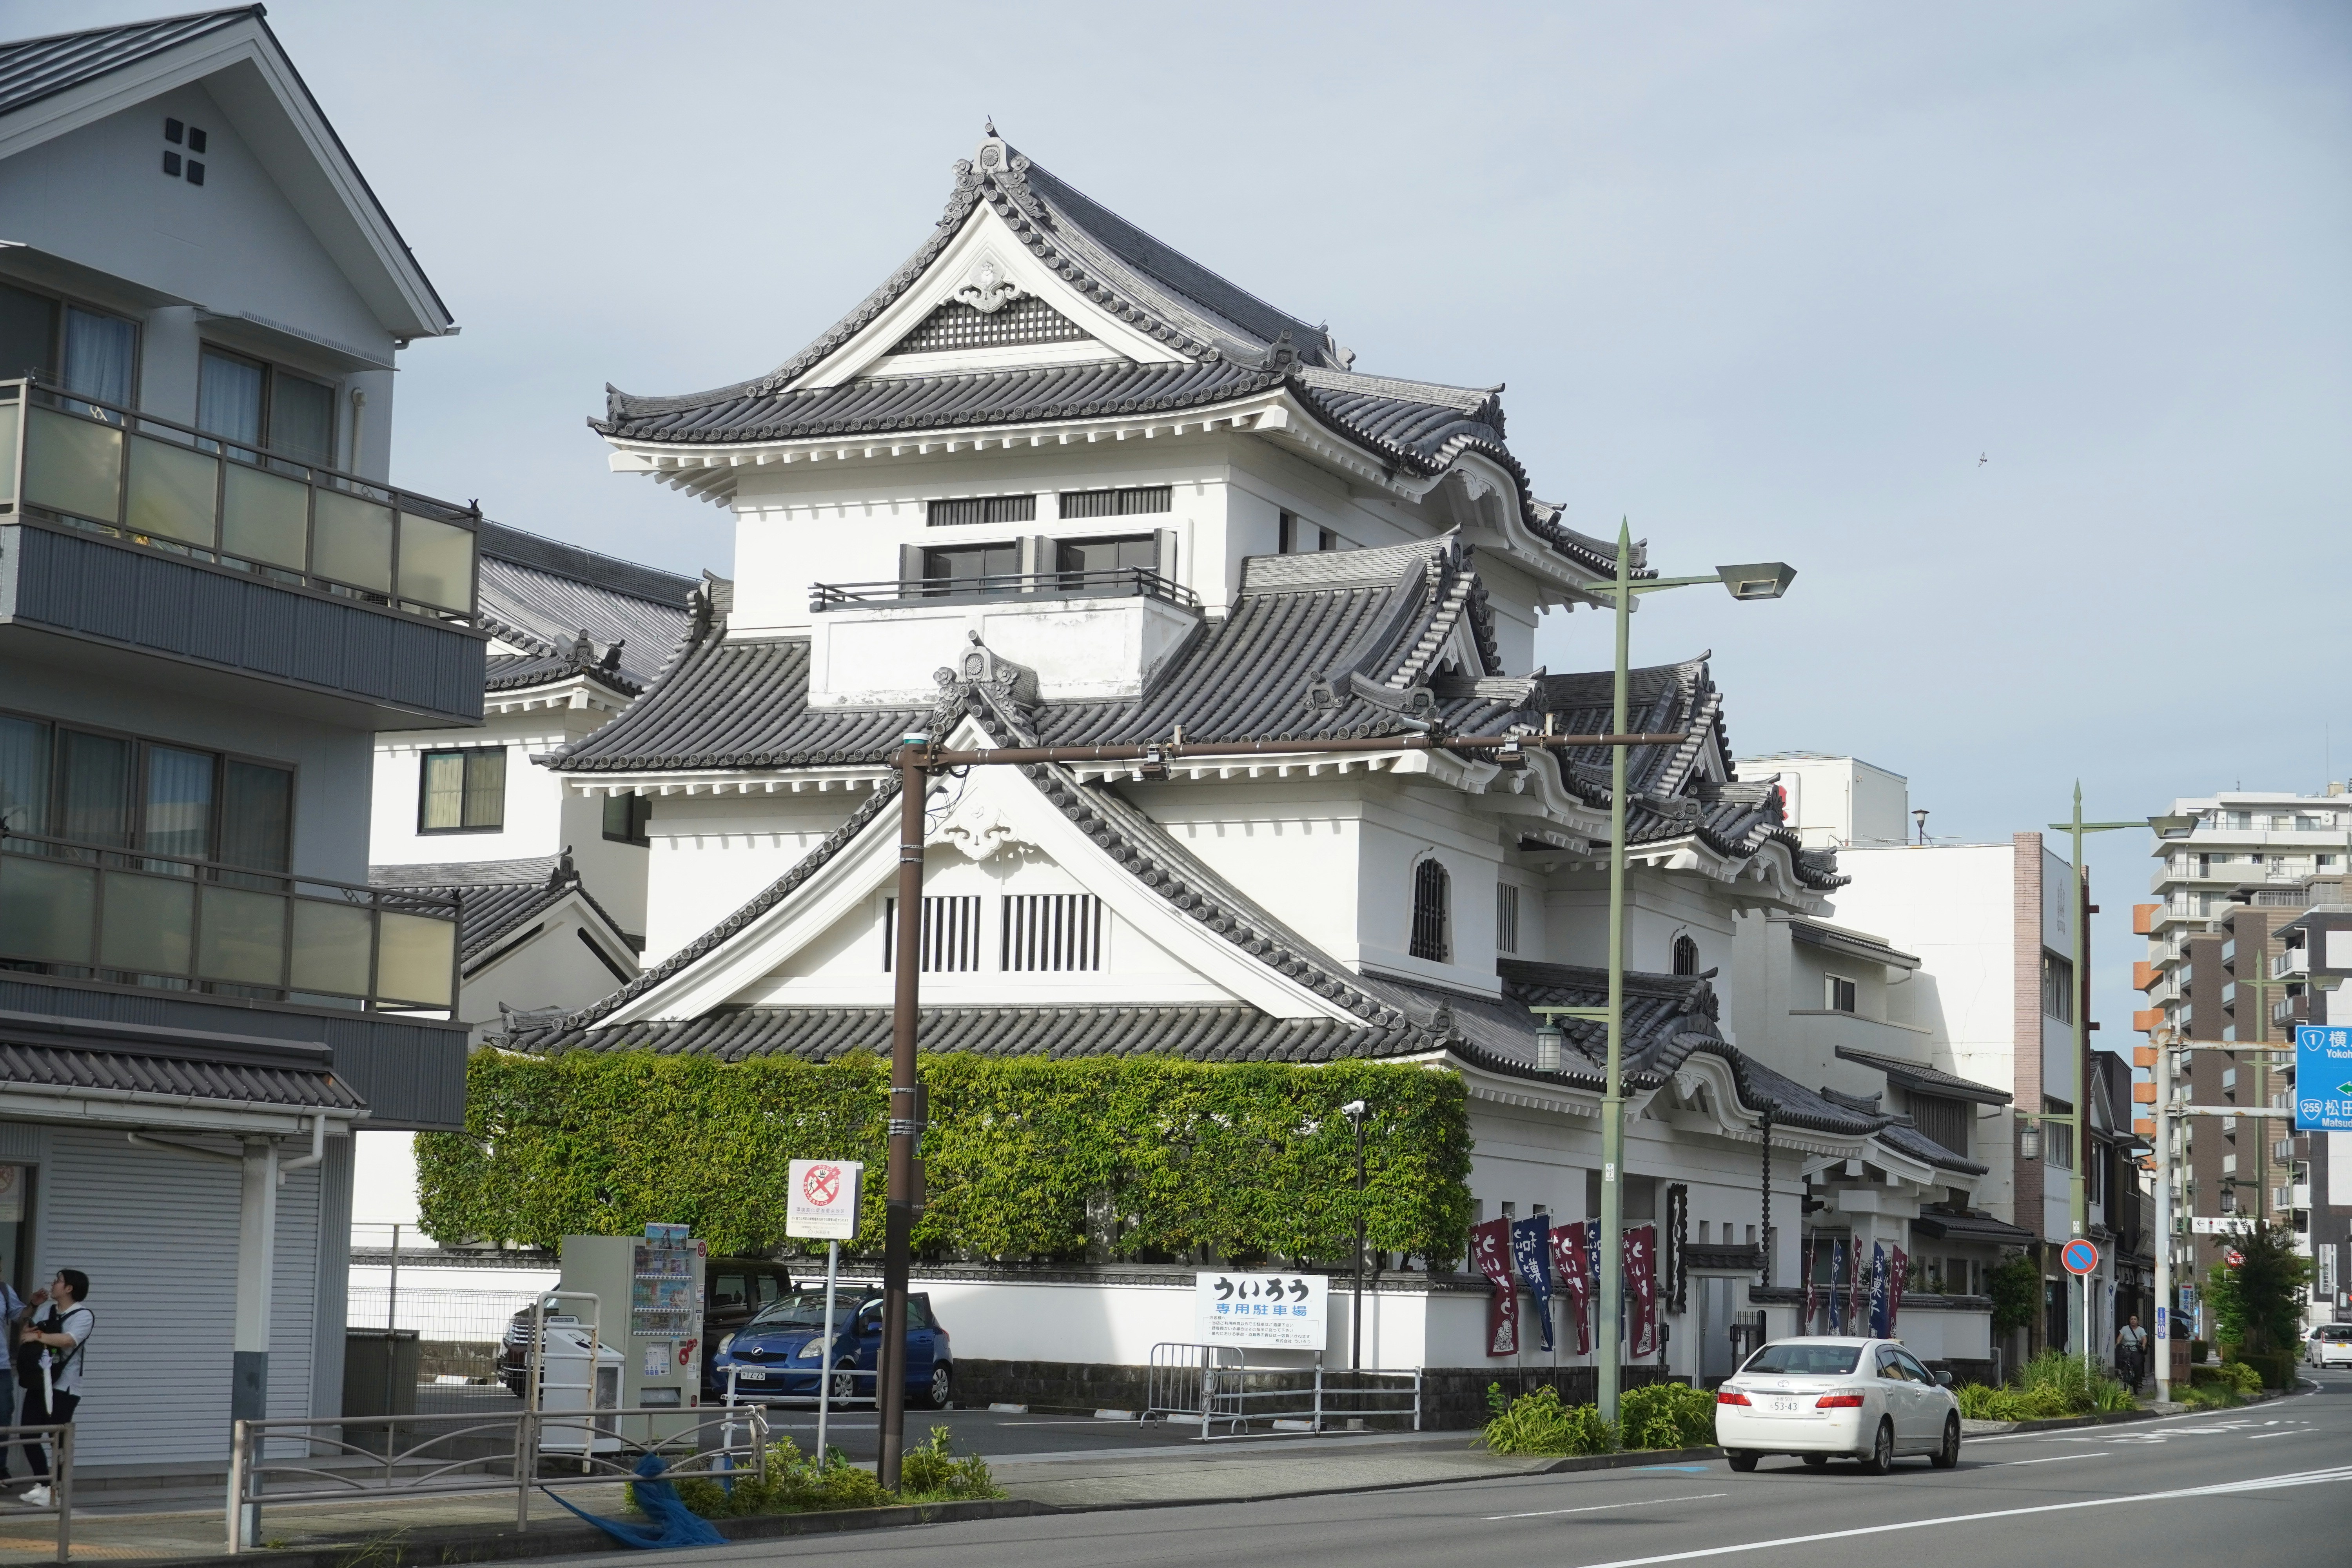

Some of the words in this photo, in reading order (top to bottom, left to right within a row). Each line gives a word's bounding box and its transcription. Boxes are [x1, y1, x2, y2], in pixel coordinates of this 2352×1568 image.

[2309, 1033, 2315, 1045] 1
[2329, 1031, 2352, 1047] 横
[2303, 1103, 2320, 1113] 255
[2325, 1099, 2352, 1117] 松田
[1214, 1277, 1309, 1303] ういろう
[1215, 1303, 1307, 1316] 専用駐車場
[2158, 1325, 2165, 1333] 10
[1775, 1402, 1797, 1411] 53-43
